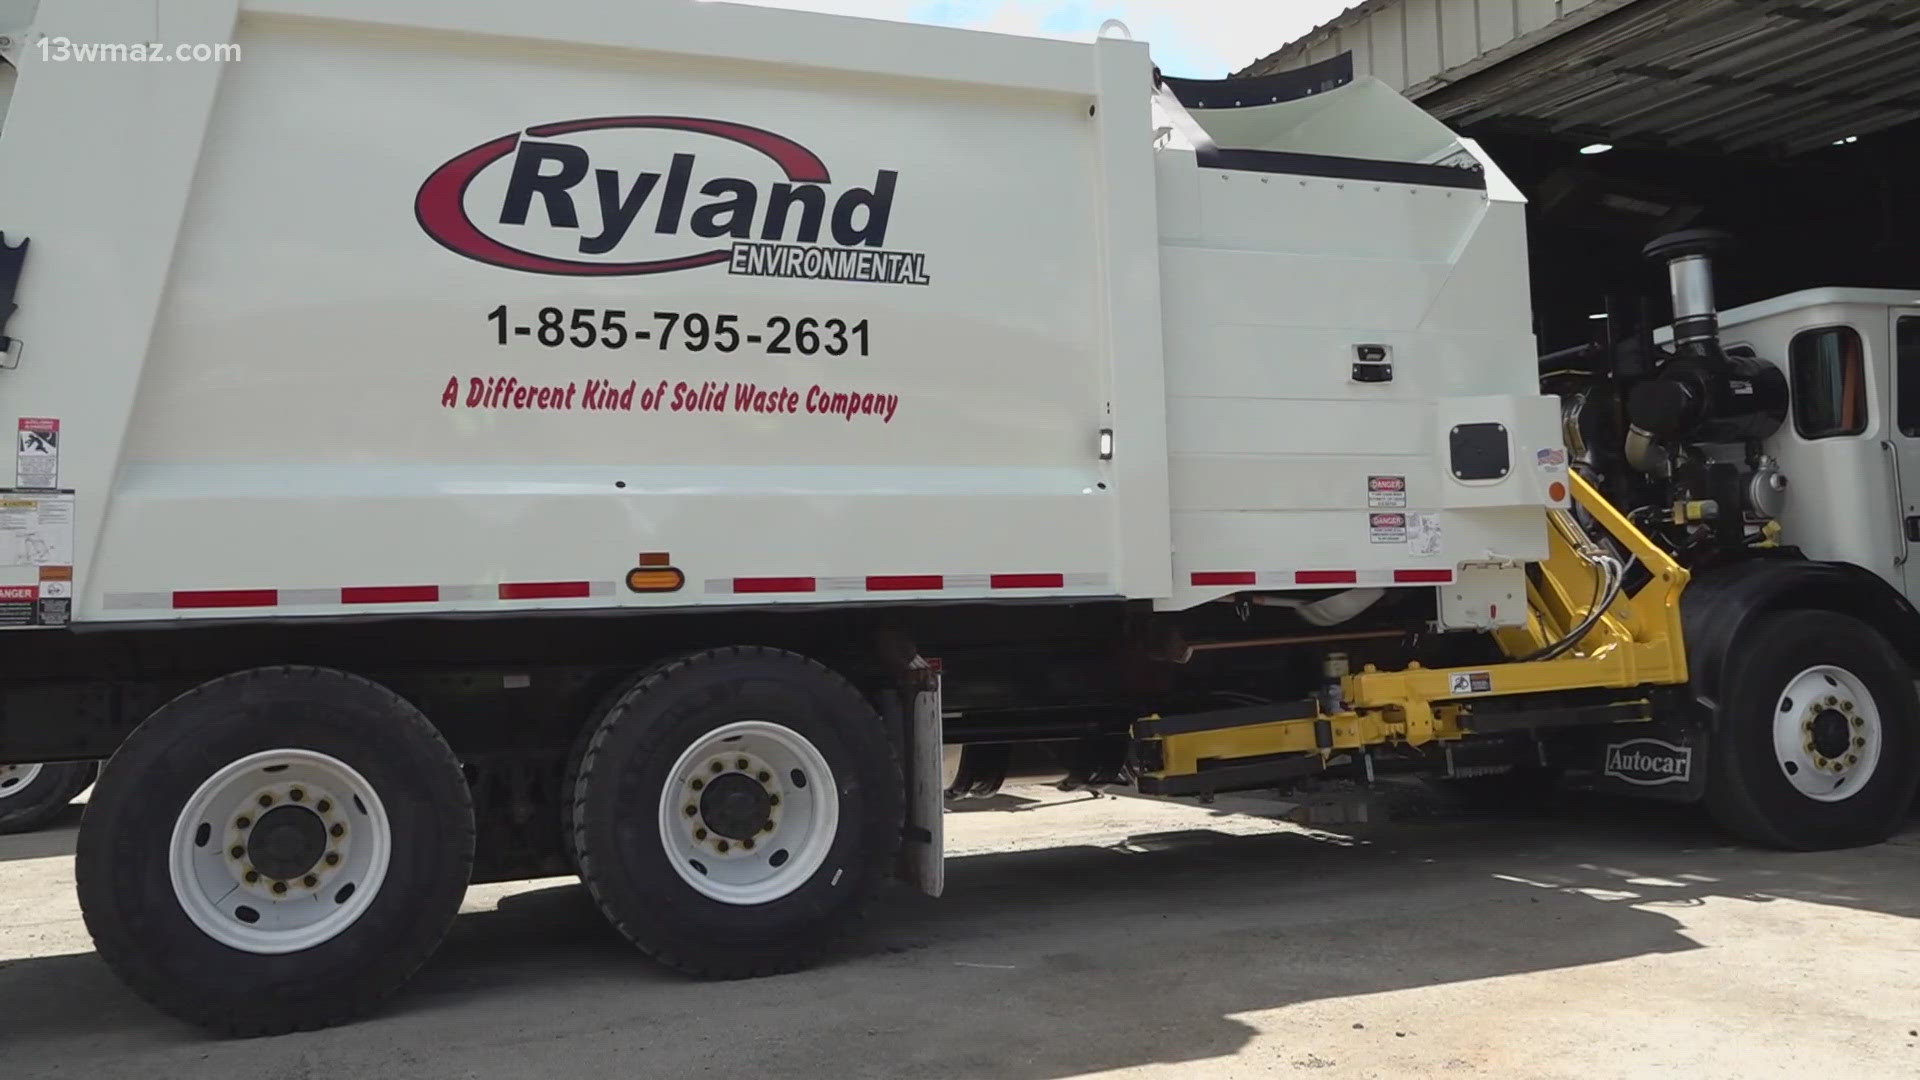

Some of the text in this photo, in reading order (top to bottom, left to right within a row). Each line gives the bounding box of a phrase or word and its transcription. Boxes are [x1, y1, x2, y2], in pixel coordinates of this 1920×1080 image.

[499, 140, 899, 254] Ryland
[730, 242, 929, 285] ENVIRONMENTAL
[487, 305, 869, 357] 1-855-795-2631
[442, 375, 899, 424] A Different Kind of Solid Waste Company
[1371, 480, 1401, 489] DANGER
[1373, 516, 1401, 525] DANGER
[0, 589, 32, 598] ANGER
[1610, 749, 1686, 774] Autocar
